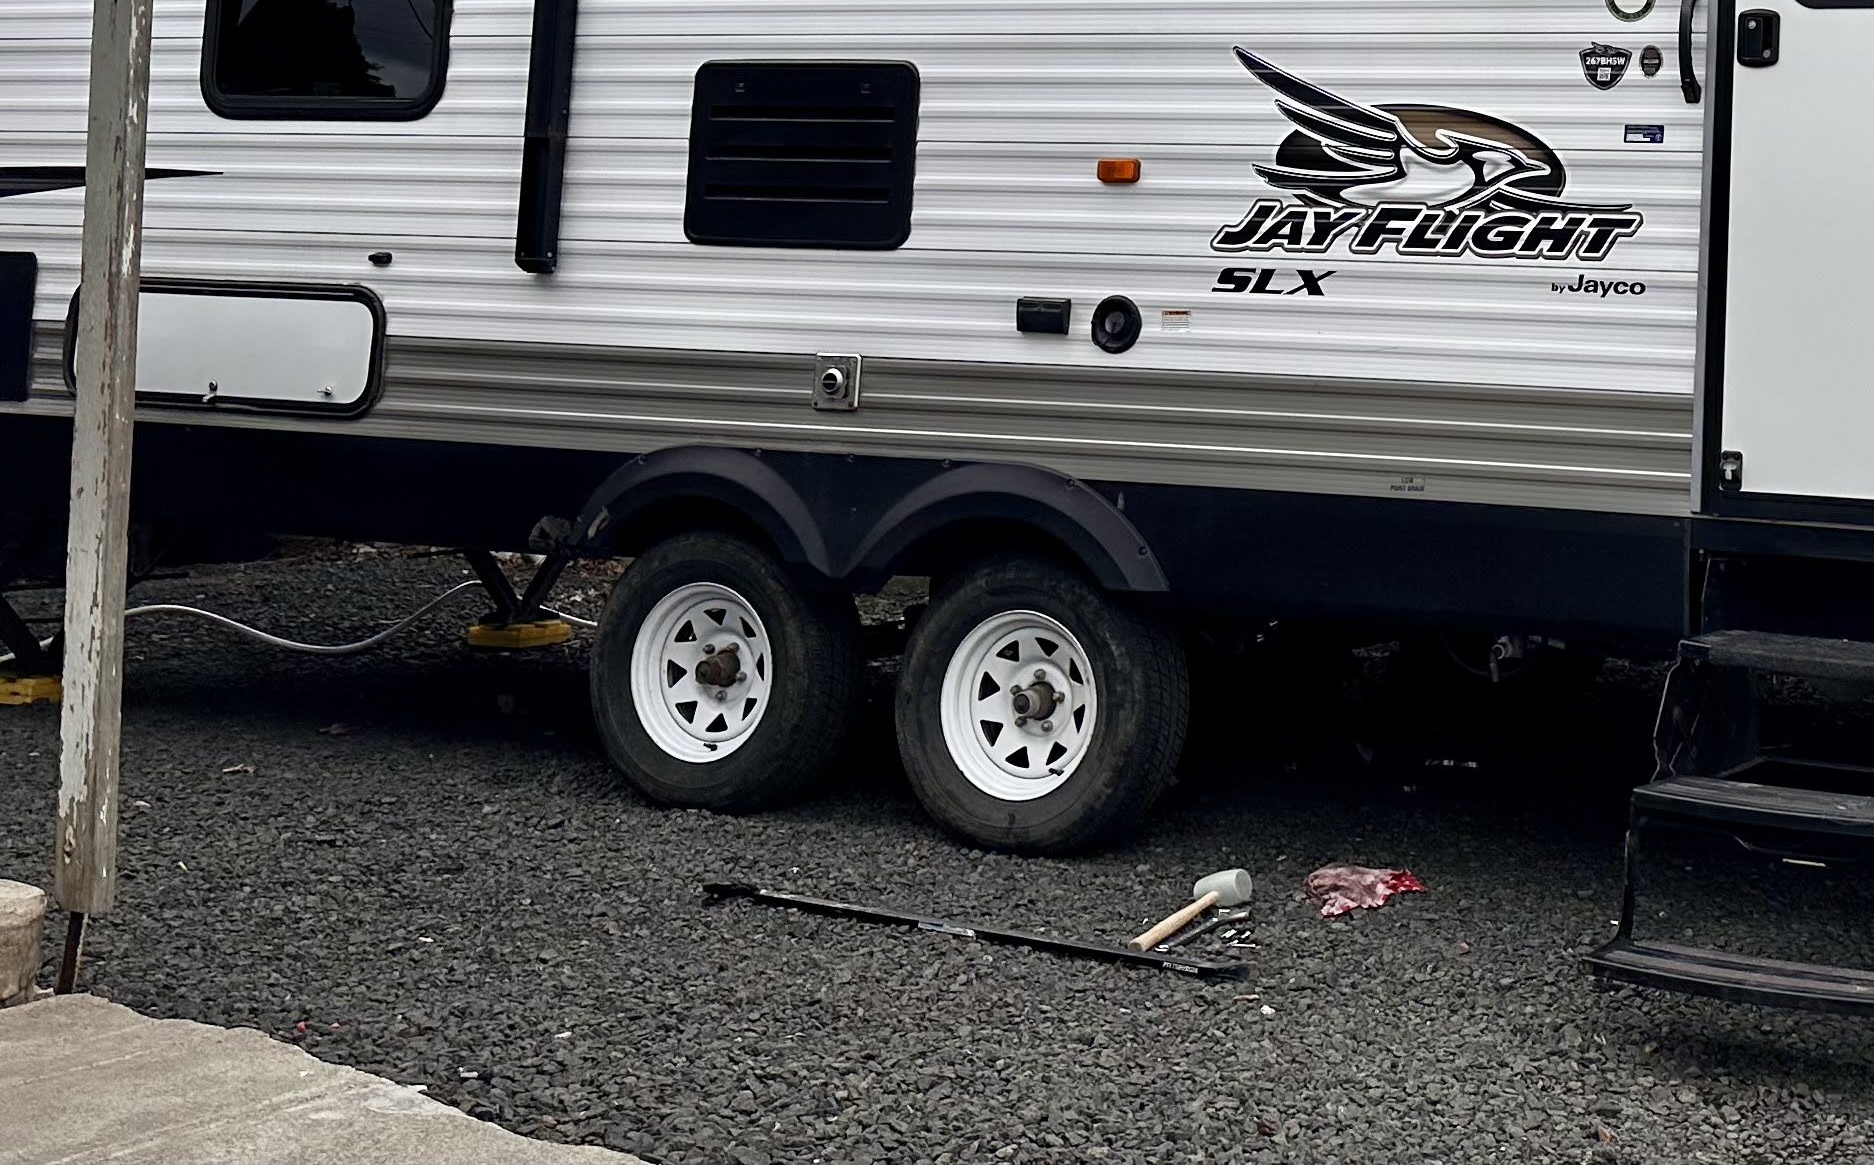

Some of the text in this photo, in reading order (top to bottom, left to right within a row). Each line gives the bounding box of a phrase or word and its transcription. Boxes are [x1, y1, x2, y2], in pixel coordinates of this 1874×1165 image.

[1212, 198, 1641, 257] JAY FLIGHT
[1211, 266, 1339, 297] SLX
[1551, 273, 1647, 299] by Jayco
